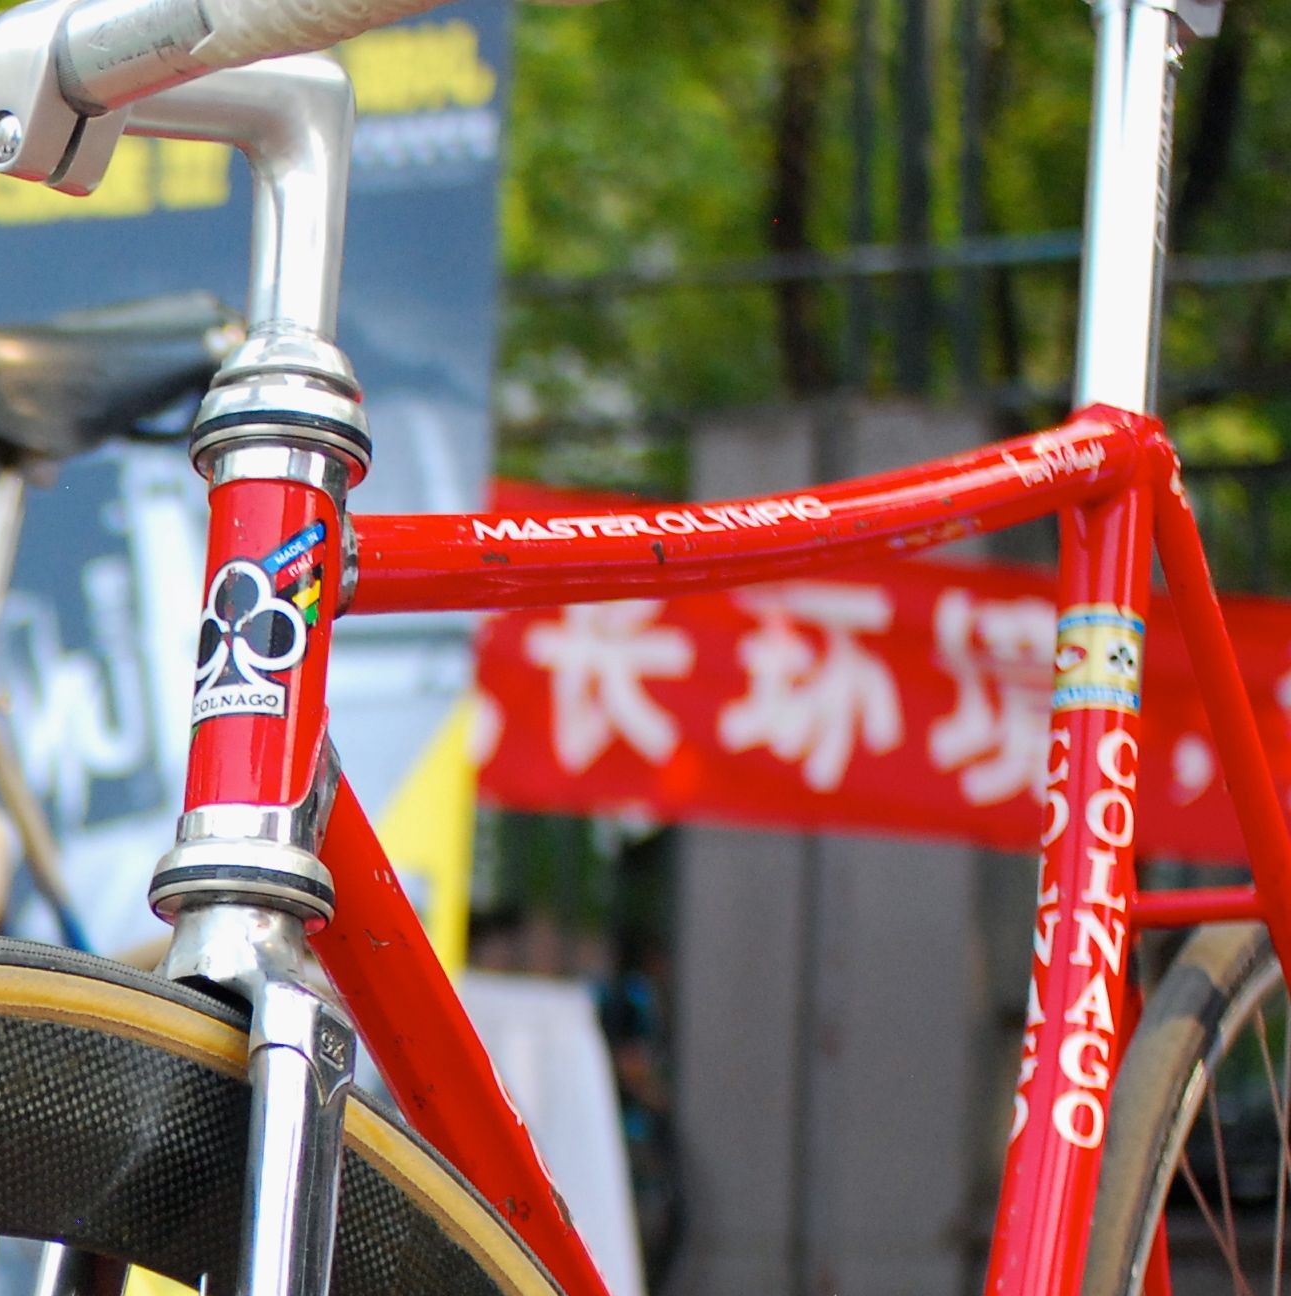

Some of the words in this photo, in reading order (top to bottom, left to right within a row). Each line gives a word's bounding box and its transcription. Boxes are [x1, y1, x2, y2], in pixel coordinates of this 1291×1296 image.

[472, 515, 665, 541] MASTER
[655, 496, 832, 534] OLYMPIC
[273, 542, 305, 565] MADE
[306, 531, 320, 546] IN
[287, 551, 315, 578] ITALY
[193, 694, 280, 717] COLNAGO
[1052, 727, 1139, 1149] COLNAGO
